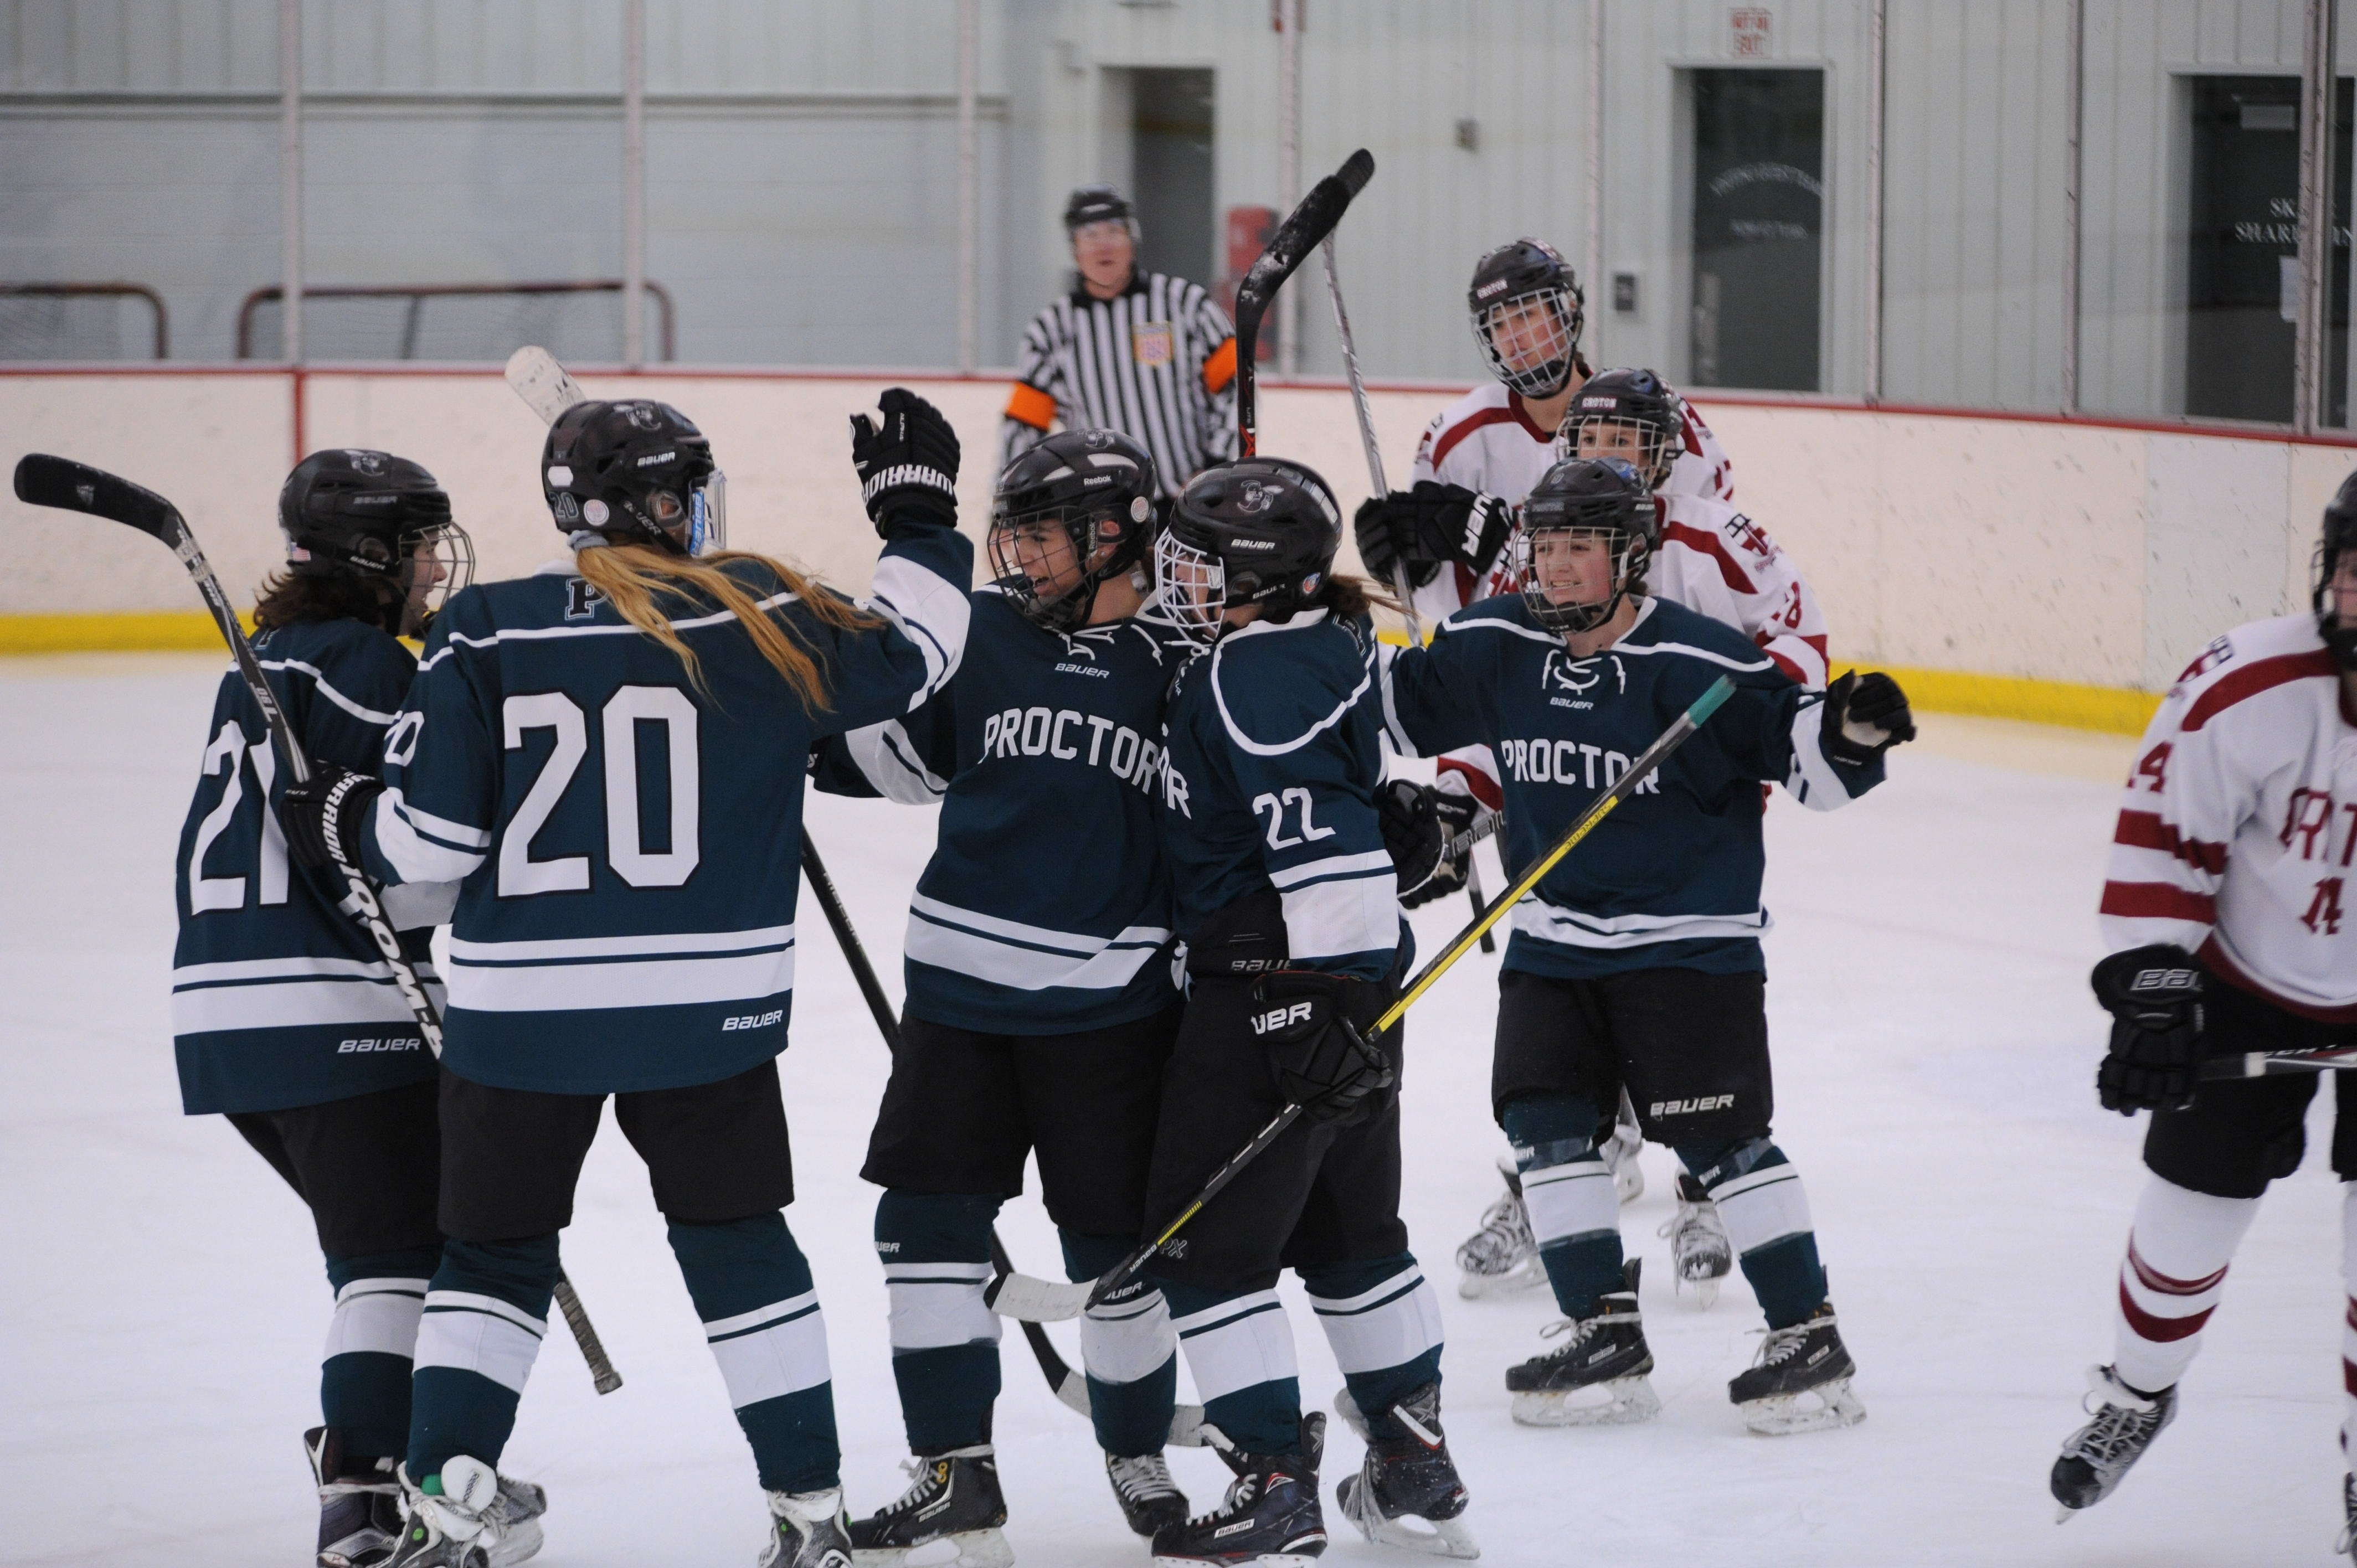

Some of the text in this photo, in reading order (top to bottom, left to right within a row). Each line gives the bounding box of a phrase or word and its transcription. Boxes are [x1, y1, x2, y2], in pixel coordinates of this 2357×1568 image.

[1582, 397, 1617, 408] GROTON
[637, 452, 675, 467] BAUER
[862, 463, 953, 506] WARRIOR
[1084, 474, 1111, 486] Reebok
[1231, 539, 1275, 550] BAUER
[1054, 663, 1110, 679] BAUER
[1550, 697, 1594, 710] BAUER
[978, 706, 1159, 795] PROCTOR
[1501, 739, 1660, 794] PROCTOR
[498, 685, 699, 897] 20
[189, 720, 290, 916] 21
[1252, 788, 1336, 850] 22
[1565, 804, 1612, 851] SUPREME
[722, 1009, 783, 1030] BAUER
[337, 1038, 421, 1053] BAUER
[1650, 1094, 1734, 1117] BAUER
[1129, 1244, 1157, 1272] BAUER
[918, 1501, 951, 1523] BAUER
[1218, 1521, 1252, 1535] BAUER
